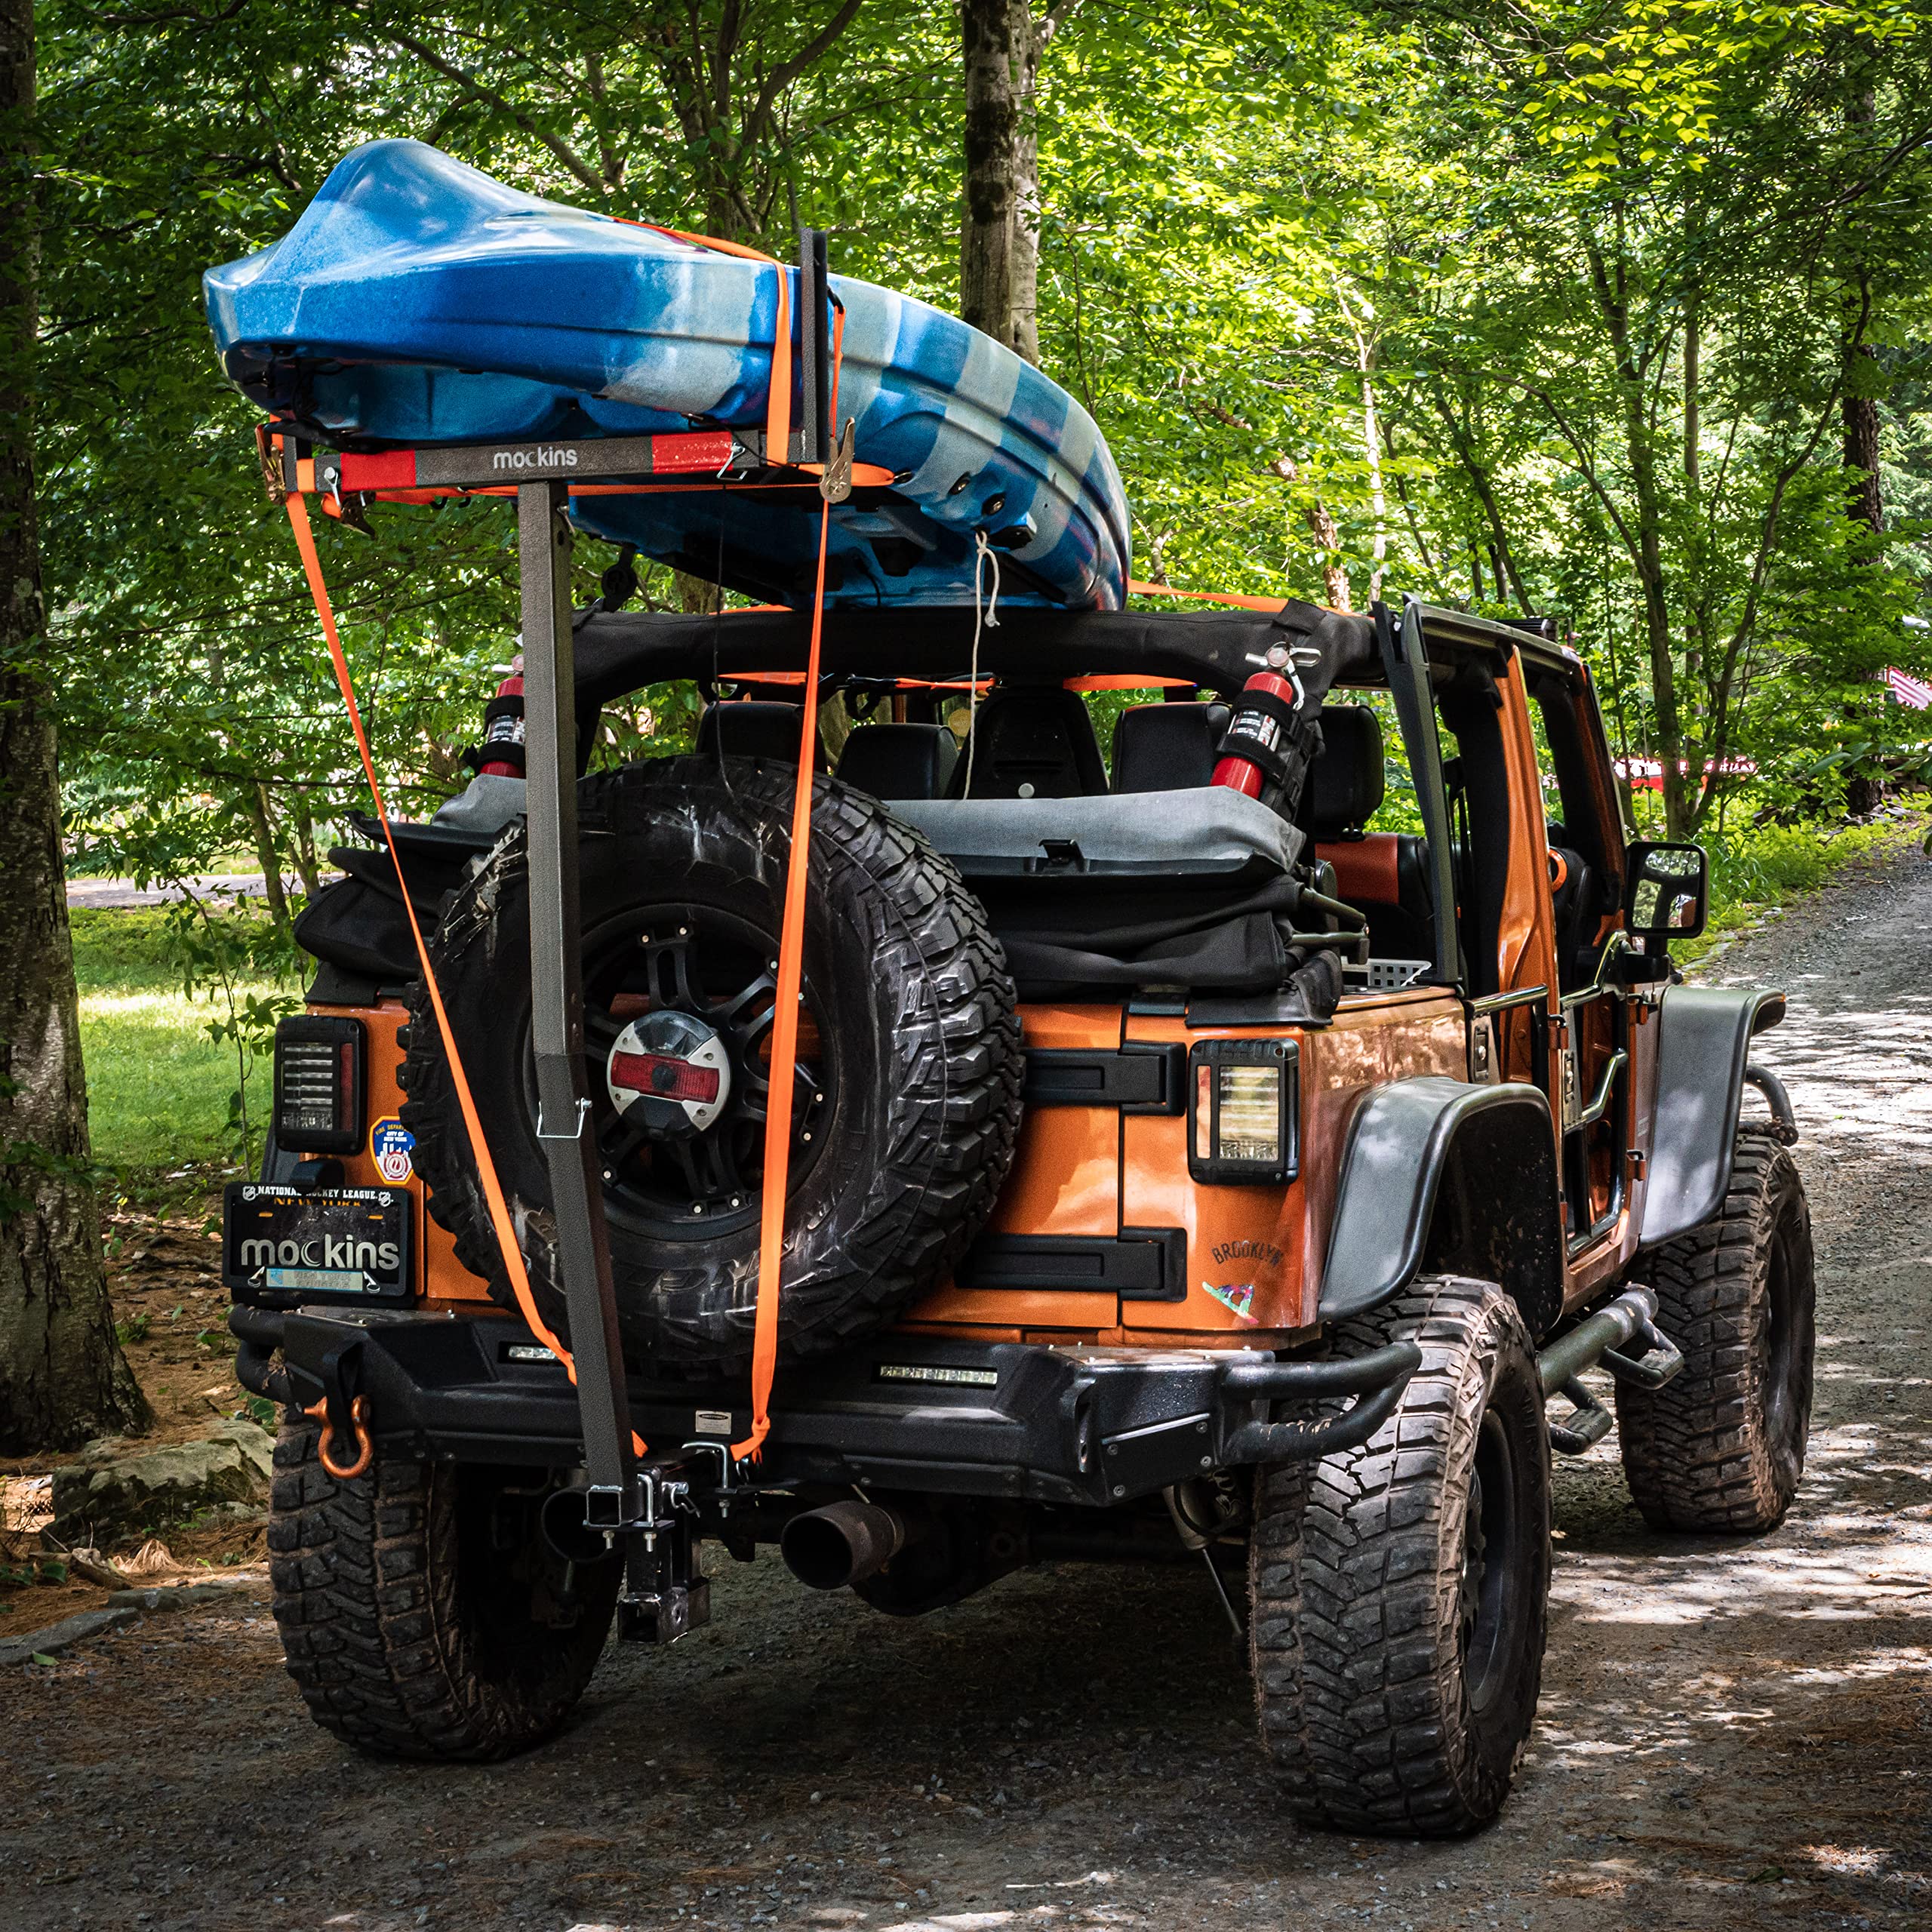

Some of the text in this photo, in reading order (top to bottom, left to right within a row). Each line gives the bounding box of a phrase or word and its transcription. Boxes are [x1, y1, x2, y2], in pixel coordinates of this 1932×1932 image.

[494, 446, 578, 469] mockins
[241, 1233, 400, 1271] mockins
[1211, 1240, 1284, 1268] BROOKLYN
